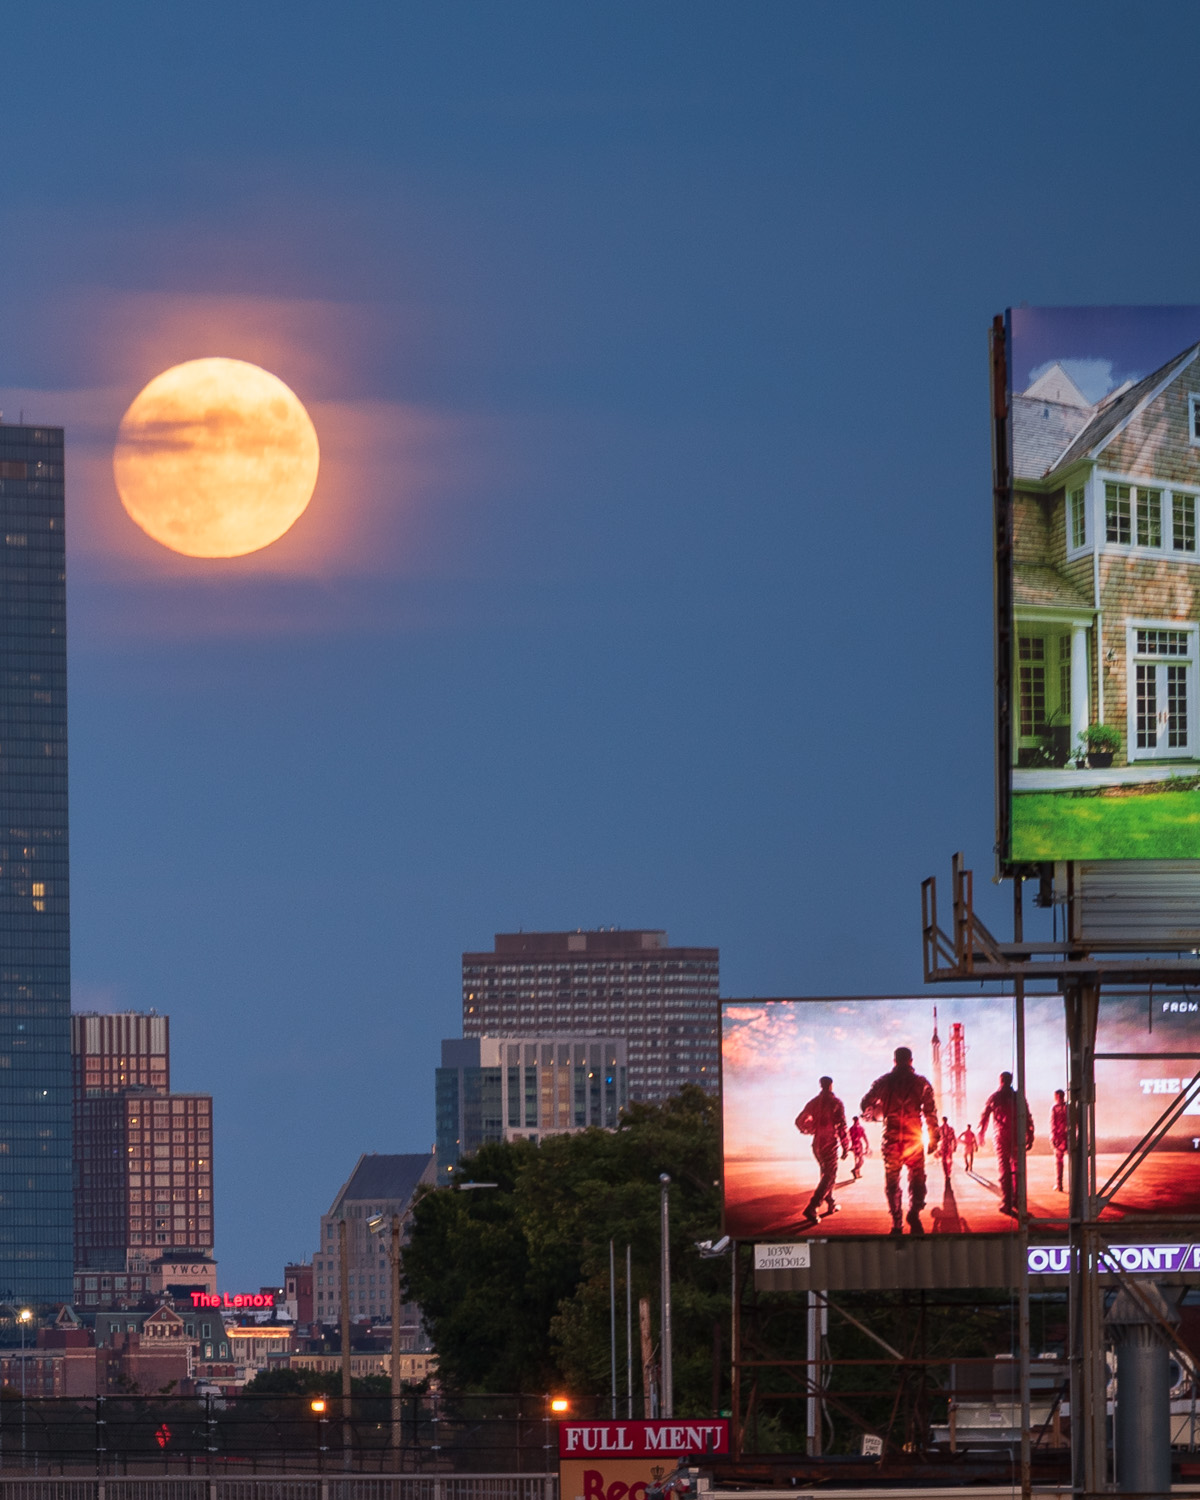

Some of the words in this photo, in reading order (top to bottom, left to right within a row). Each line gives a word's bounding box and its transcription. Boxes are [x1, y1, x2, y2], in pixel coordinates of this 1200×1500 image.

[1162, 1002, 1199, 1012] FROM
[1139, 1078, 1180, 1094] THE
[767, 1246, 794, 1256] 103W
[759, 1257, 806, 1268] 2018D012
[171, 1265, 208, 1274] YWCA
[191, 1292, 220, 1307] The
[223, 1292, 274, 1308] Lenox
[565, 1427, 633, 1451] FULL
[644, 1426, 723, 1450] MENU
